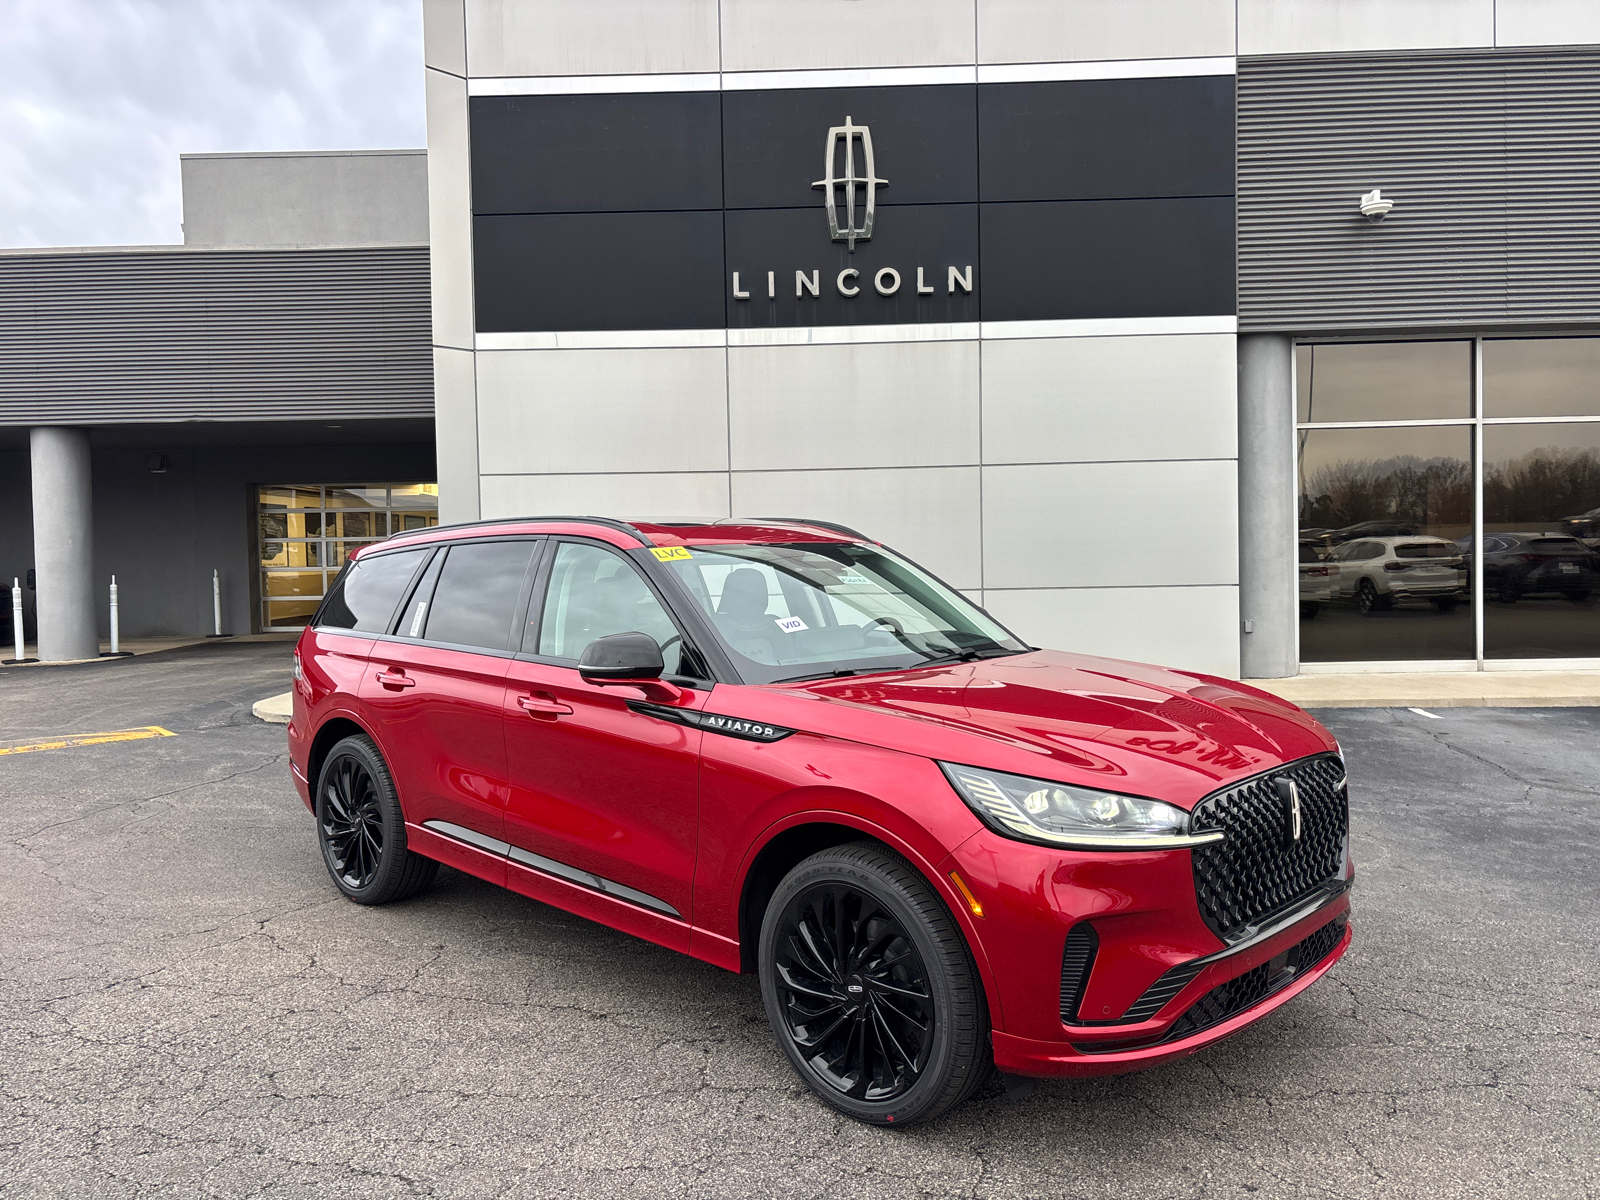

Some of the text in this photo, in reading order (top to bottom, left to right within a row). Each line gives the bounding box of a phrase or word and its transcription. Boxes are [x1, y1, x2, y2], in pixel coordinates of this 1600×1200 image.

[732, 265, 973, 299] LINCOLN
[654, 548, 689, 559] LVC
[781, 620, 801, 630] VID
[708, 716, 774, 737] AVIATOR
[787, 866, 871, 891] GOODYEAR
